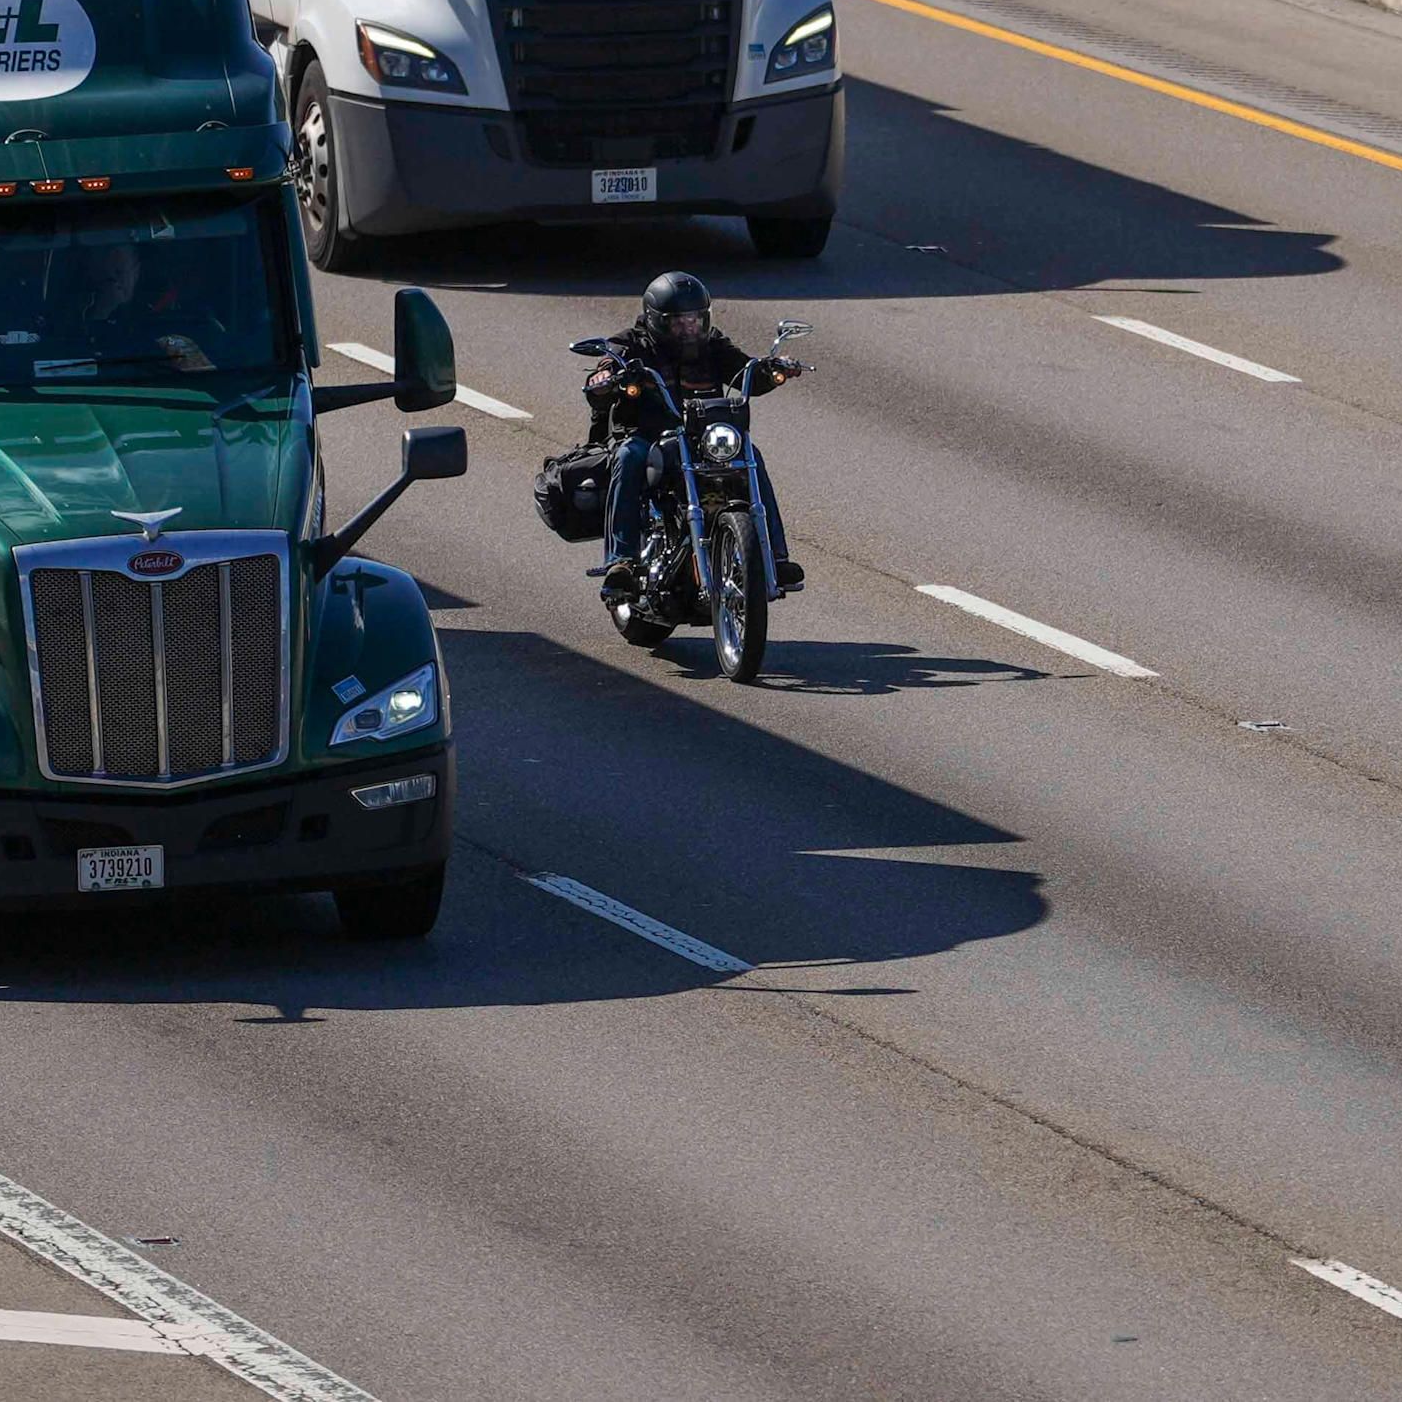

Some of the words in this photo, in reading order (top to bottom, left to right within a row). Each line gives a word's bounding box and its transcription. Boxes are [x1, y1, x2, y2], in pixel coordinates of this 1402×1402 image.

[134, 556, 178, 570] Peterbilt
[100, 849, 140, 858] INDIANA
[89, 857, 153, 879] 3739210
